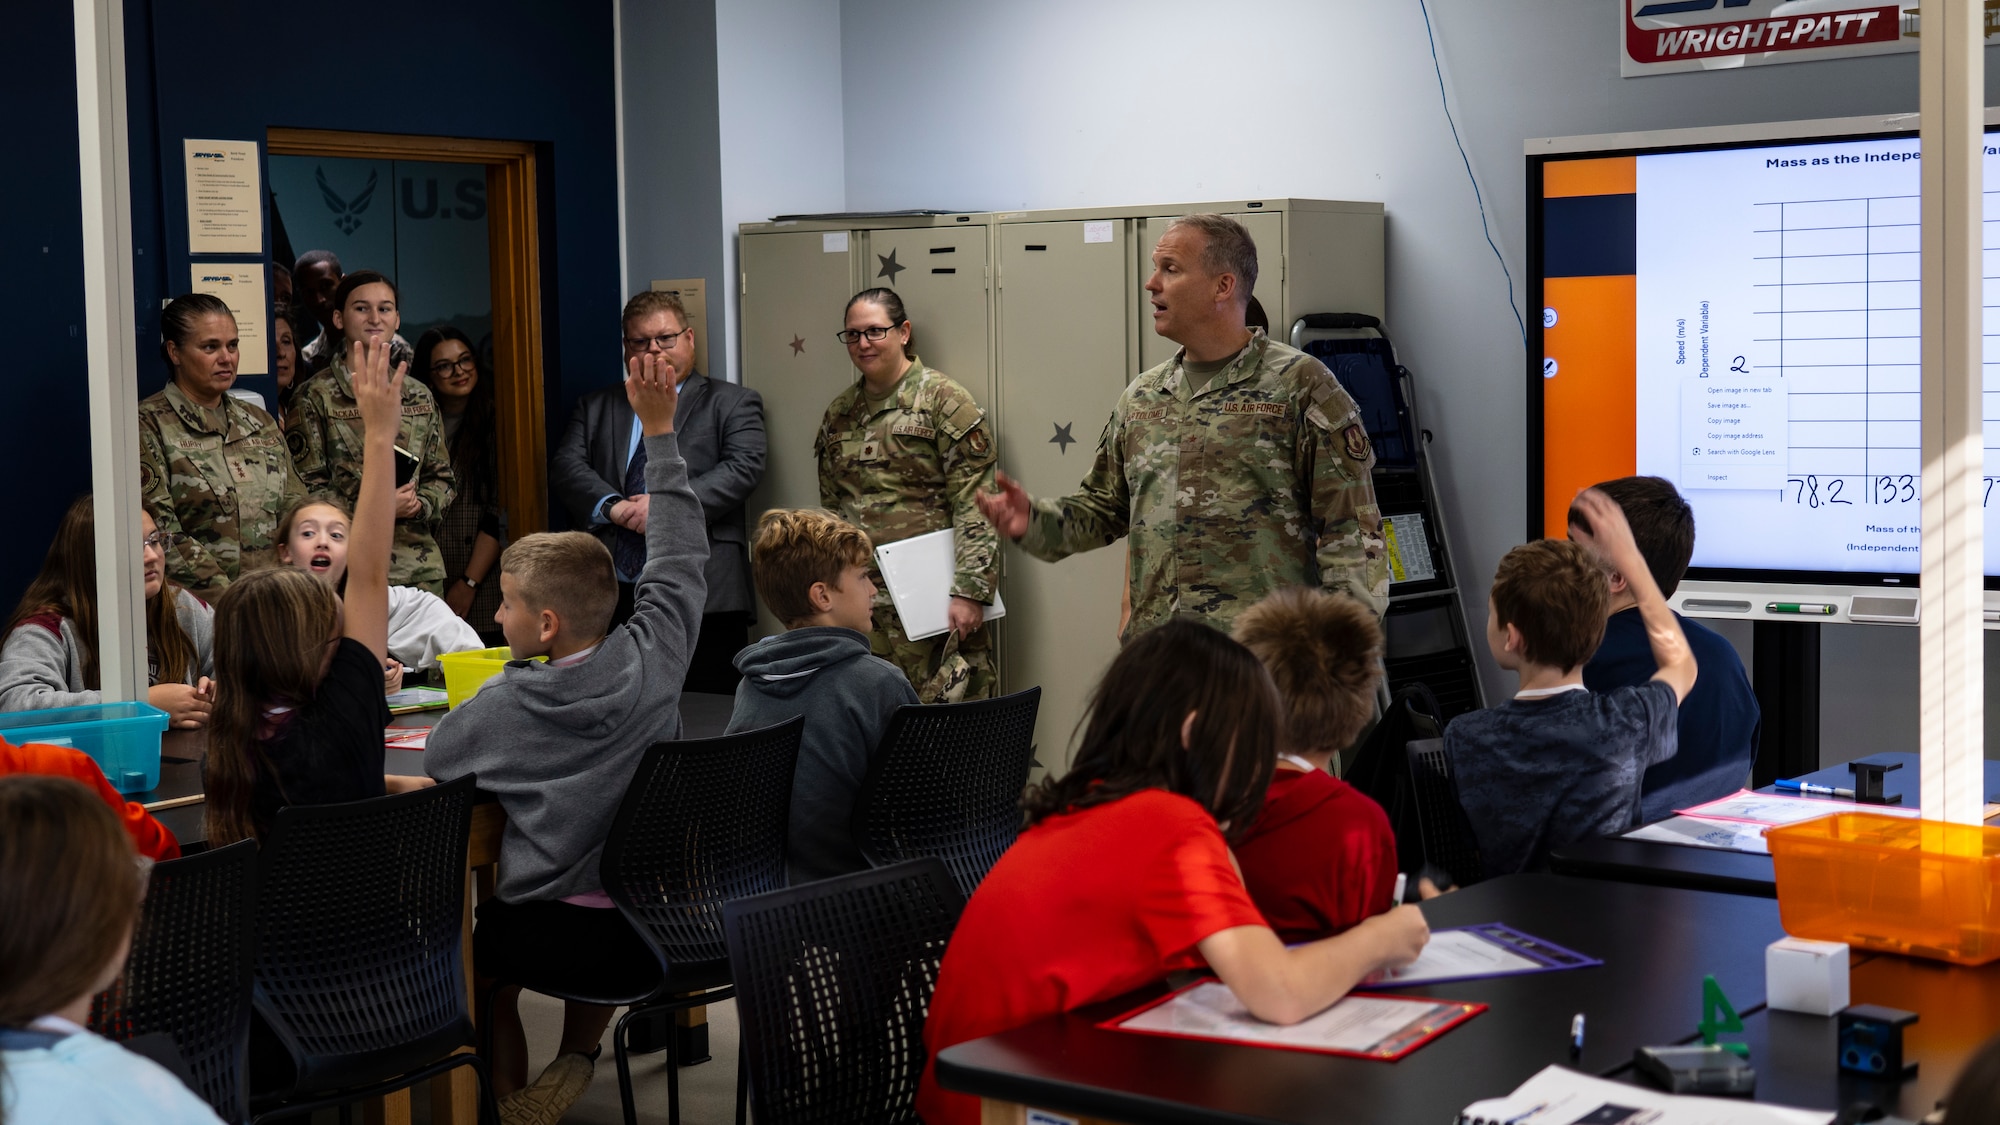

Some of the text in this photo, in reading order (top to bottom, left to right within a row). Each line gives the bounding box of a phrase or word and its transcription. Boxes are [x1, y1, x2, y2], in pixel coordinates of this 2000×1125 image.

[1656, 11, 1880, 57] WRIGHT-PATT
[1766, 151, 1921, 168] Mass as the Indepe
[1699, 300, 1710, 334] Variable)
[1676, 318, 1686, 364] Speed (m/s)
[1730, 355, 1750, 374] 2
[413, 405, 431, 414] FORCE
[1241, 403, 1254, 413] AIR
[1256, 404, 1284, 415] FORCE
[1722, 402, 1739, 410] image
[1707, 417, 1740, 425] Copy image
[914, 427, 934, 438] FORCE
[1707, 432, 1722, 440] Copy
[1723, 432, 1740, 440] image
[1740, 448, 1761, 456] Google
[1707, 474, 1728, 482] Inspect
[1787, 474, 1853, 509] 78.2
[1866, 525, 1921, 533] Mass of th
[1846, 542, 1919, 552] (Independent
